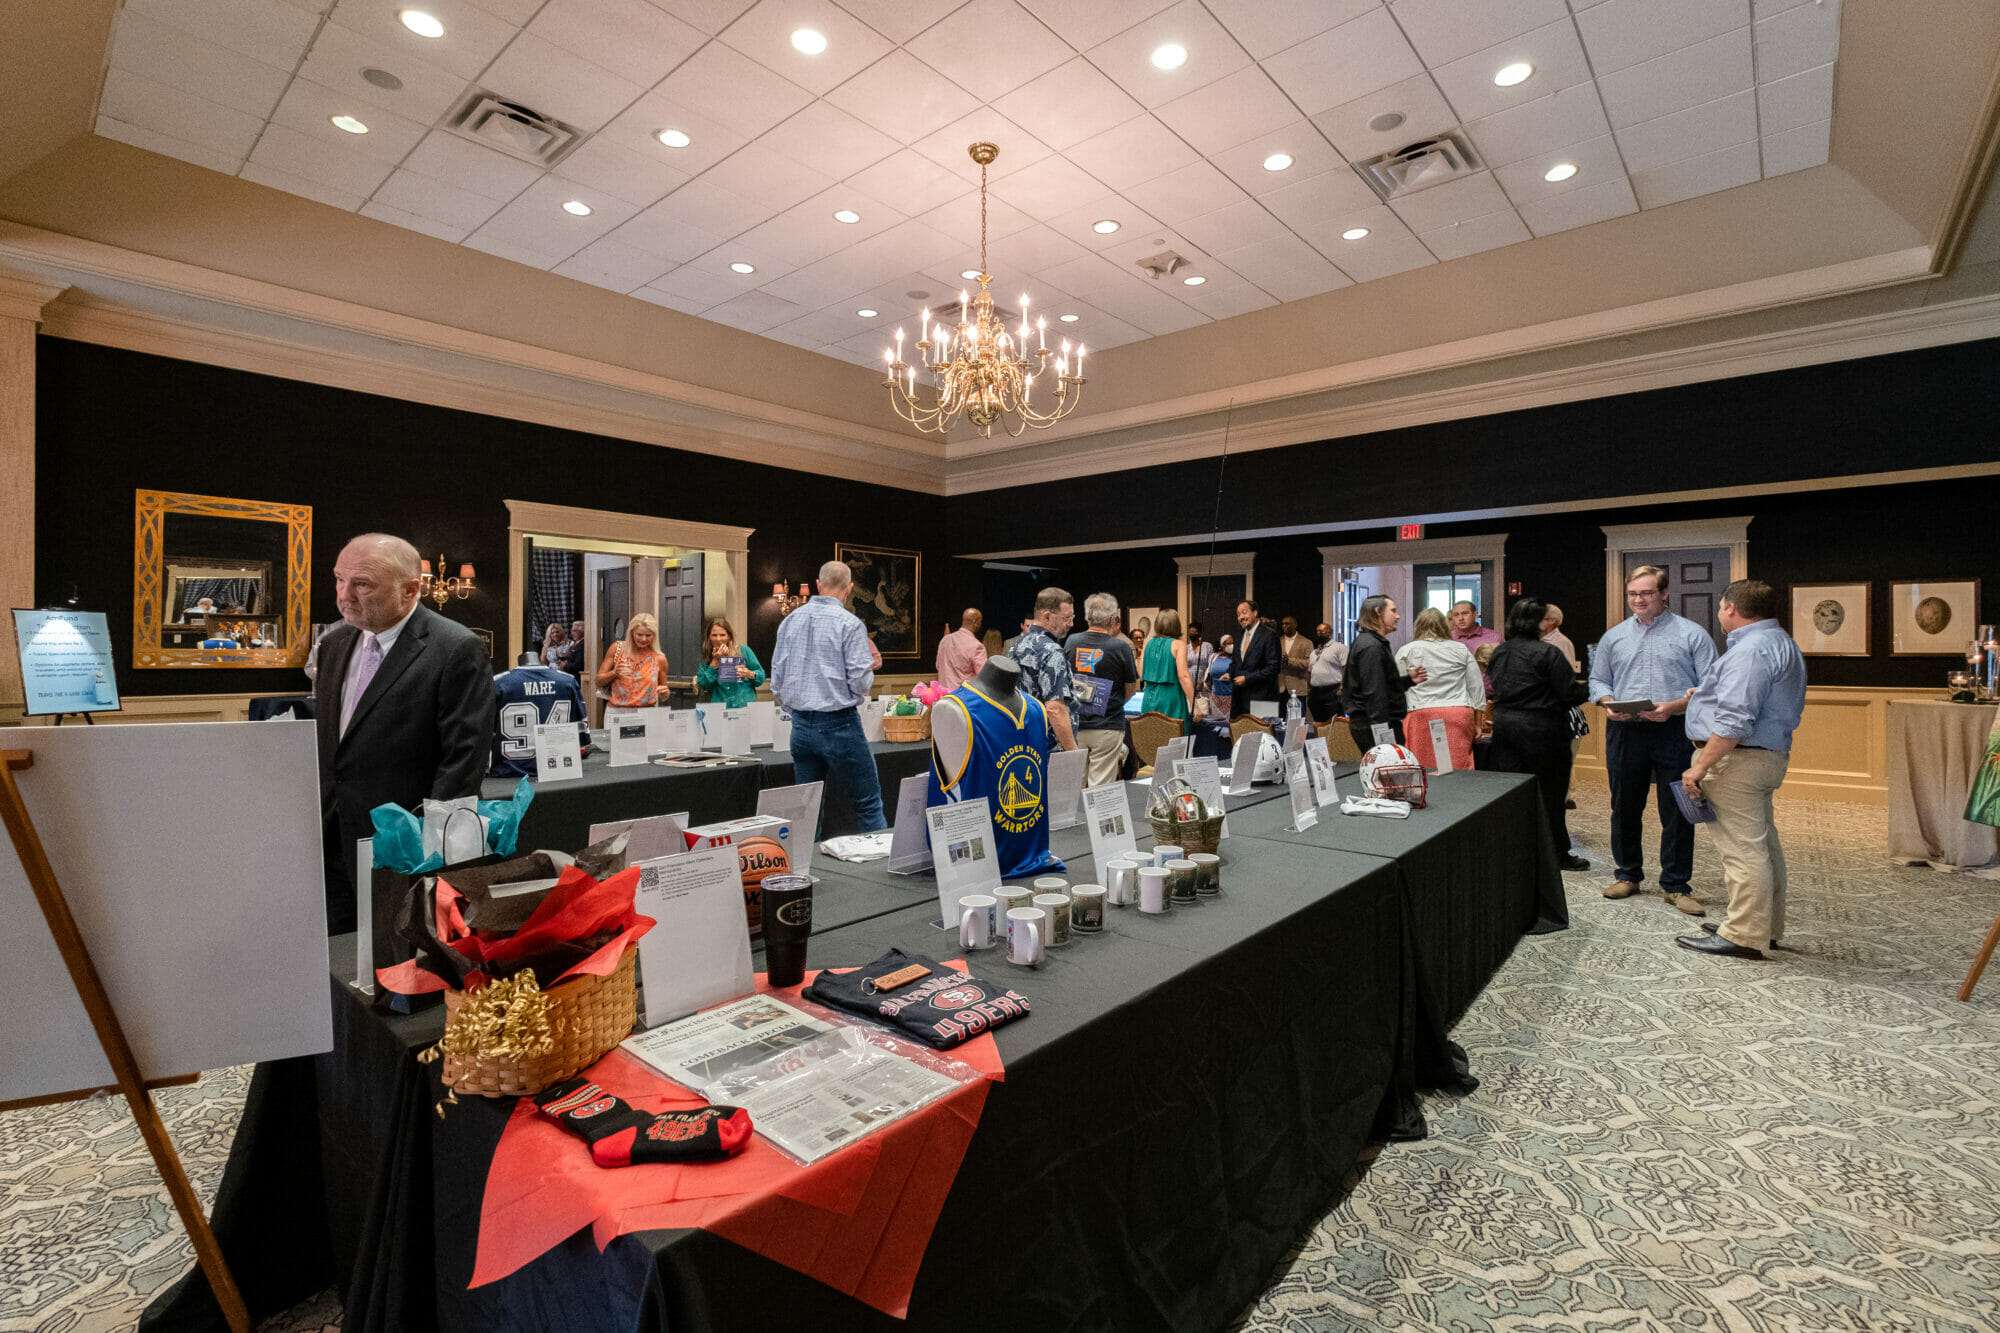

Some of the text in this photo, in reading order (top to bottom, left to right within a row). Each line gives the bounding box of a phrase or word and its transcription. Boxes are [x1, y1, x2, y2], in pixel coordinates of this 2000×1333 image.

[1401, 524, 1421, 540] EXIT
[523, 680, 556, 696] WARE
[996, 744, 1042, 769] GOLDEN STATE
[1025, 765, 1033, 785] 4
[994, 804, 1044, 834] WARRIORS
[632, 1031, 657, 1046] San
[660, 1013, 713, 1038] Francisco
[714, 998, 763, 1021] Chronicle
[933, 989, 1031, 1041] 49ERS
[679, 1037, 750, 1068] COMEBACK
[751, 1020, 801, 1044] SPECIAL
[654, 1112, 675, 1123] SAN
